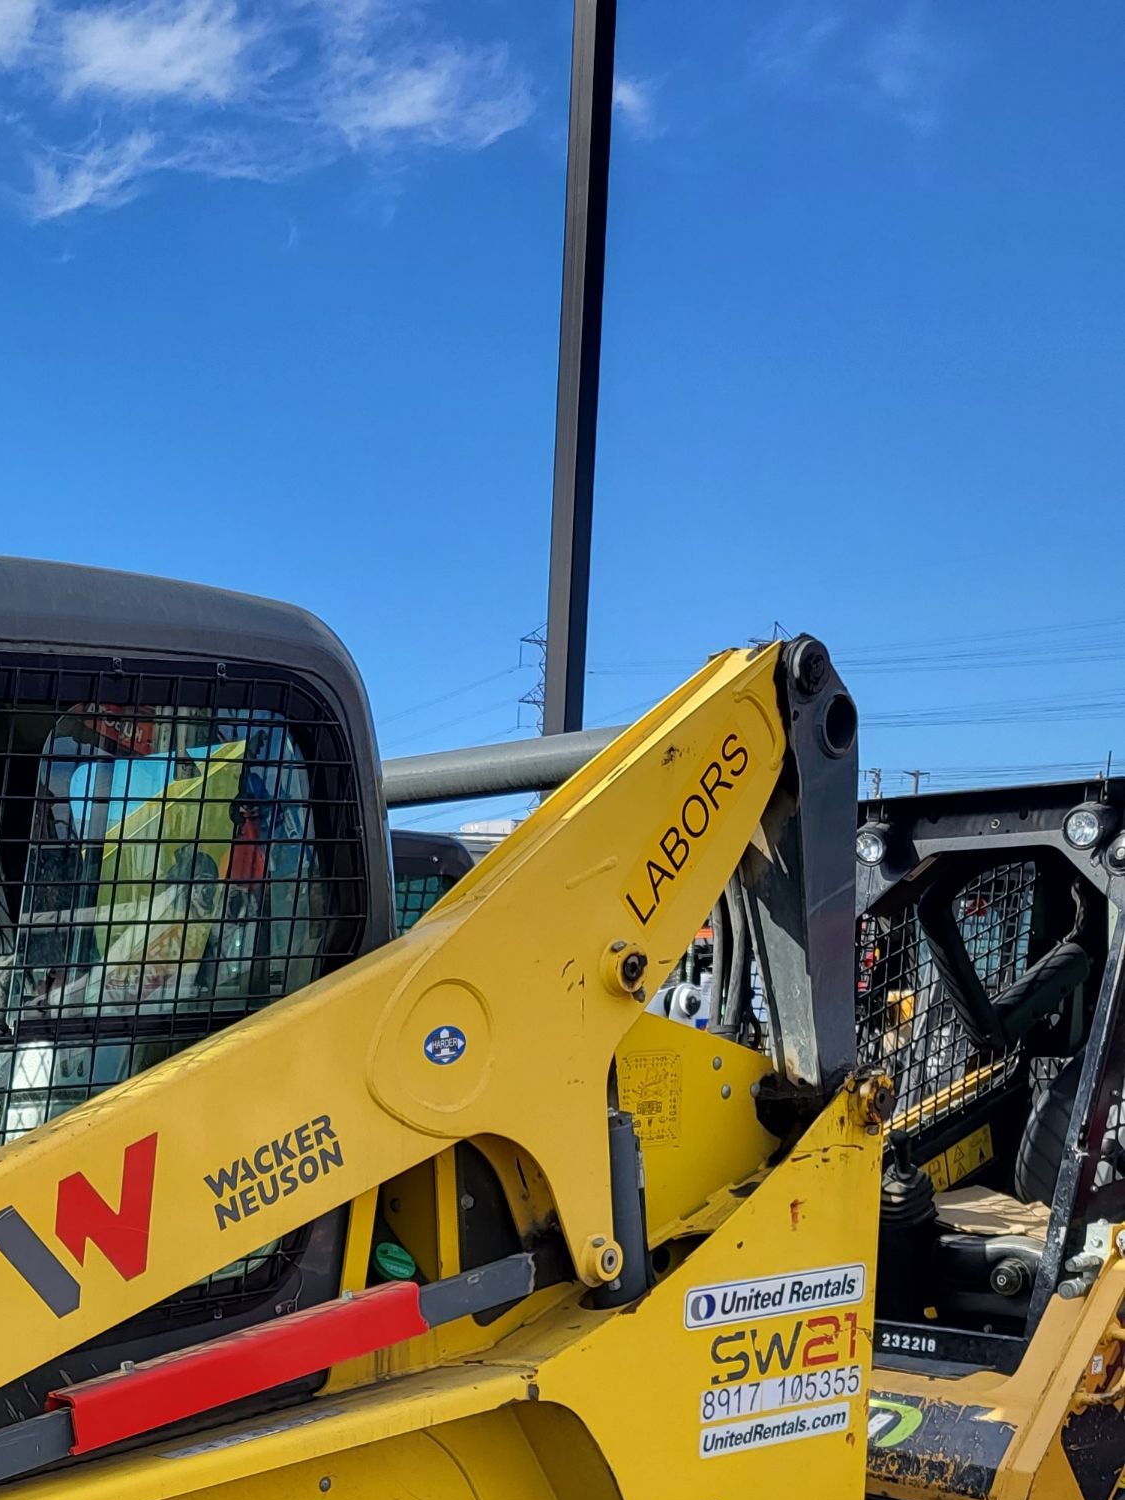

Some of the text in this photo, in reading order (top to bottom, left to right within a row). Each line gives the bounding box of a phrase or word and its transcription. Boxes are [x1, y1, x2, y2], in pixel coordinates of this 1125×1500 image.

[626, 734, 749, 926] LABORS
[203, 1114, 337, 1199] WACKER
[213, 1140, 345, 1232] NEUSON
[720, 1273, 856, 1315] United Rentals
[710, 1312, 858, 1385] SW21
[881, 1332, 937, 1353] 232218
[701, 1365, 861, 1421] 8917 105355
[702, 1410, 847, 1453] UnitedRentals.com
